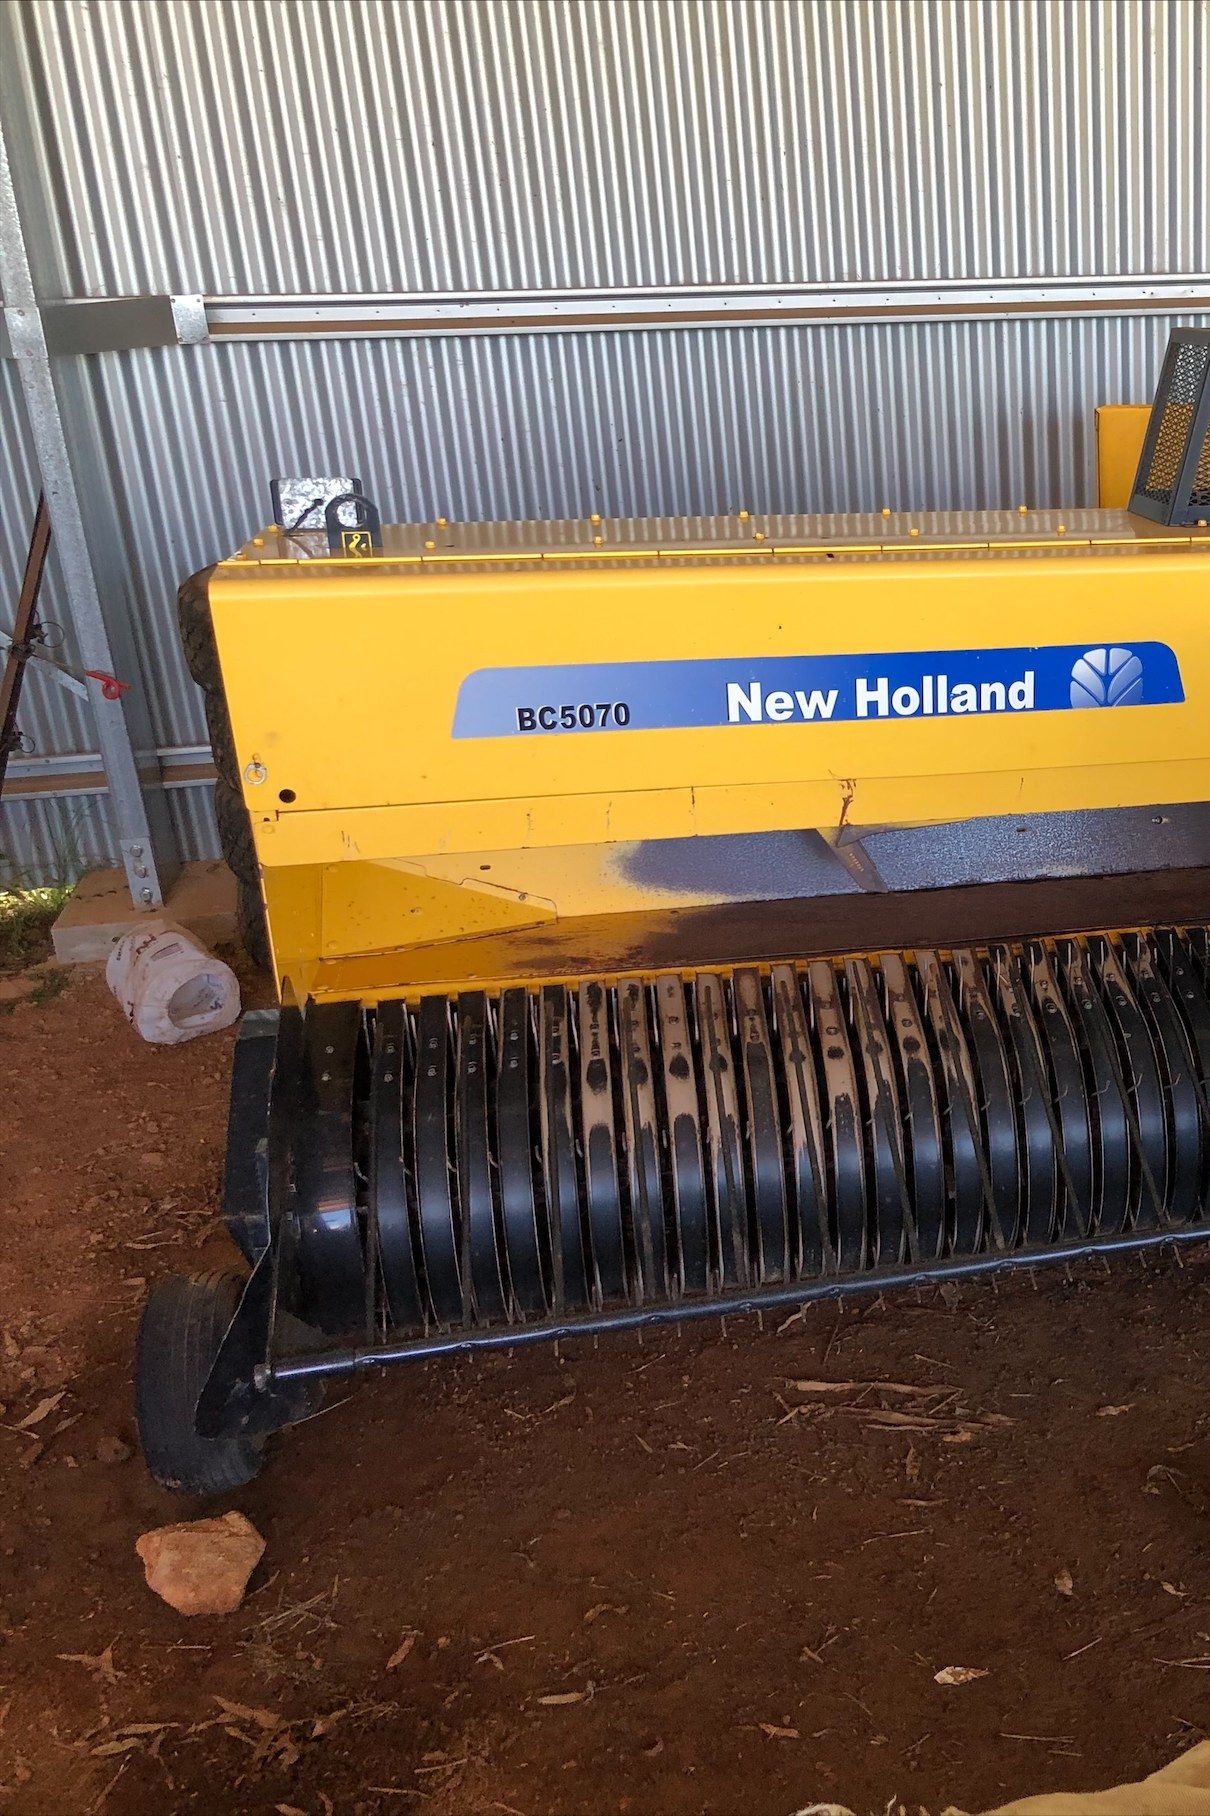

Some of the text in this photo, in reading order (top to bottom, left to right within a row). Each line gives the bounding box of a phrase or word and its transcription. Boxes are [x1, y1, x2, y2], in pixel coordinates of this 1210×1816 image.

[516, 702, 631, 731] BC5070
[726, 671, 1035, 723] New Holland
